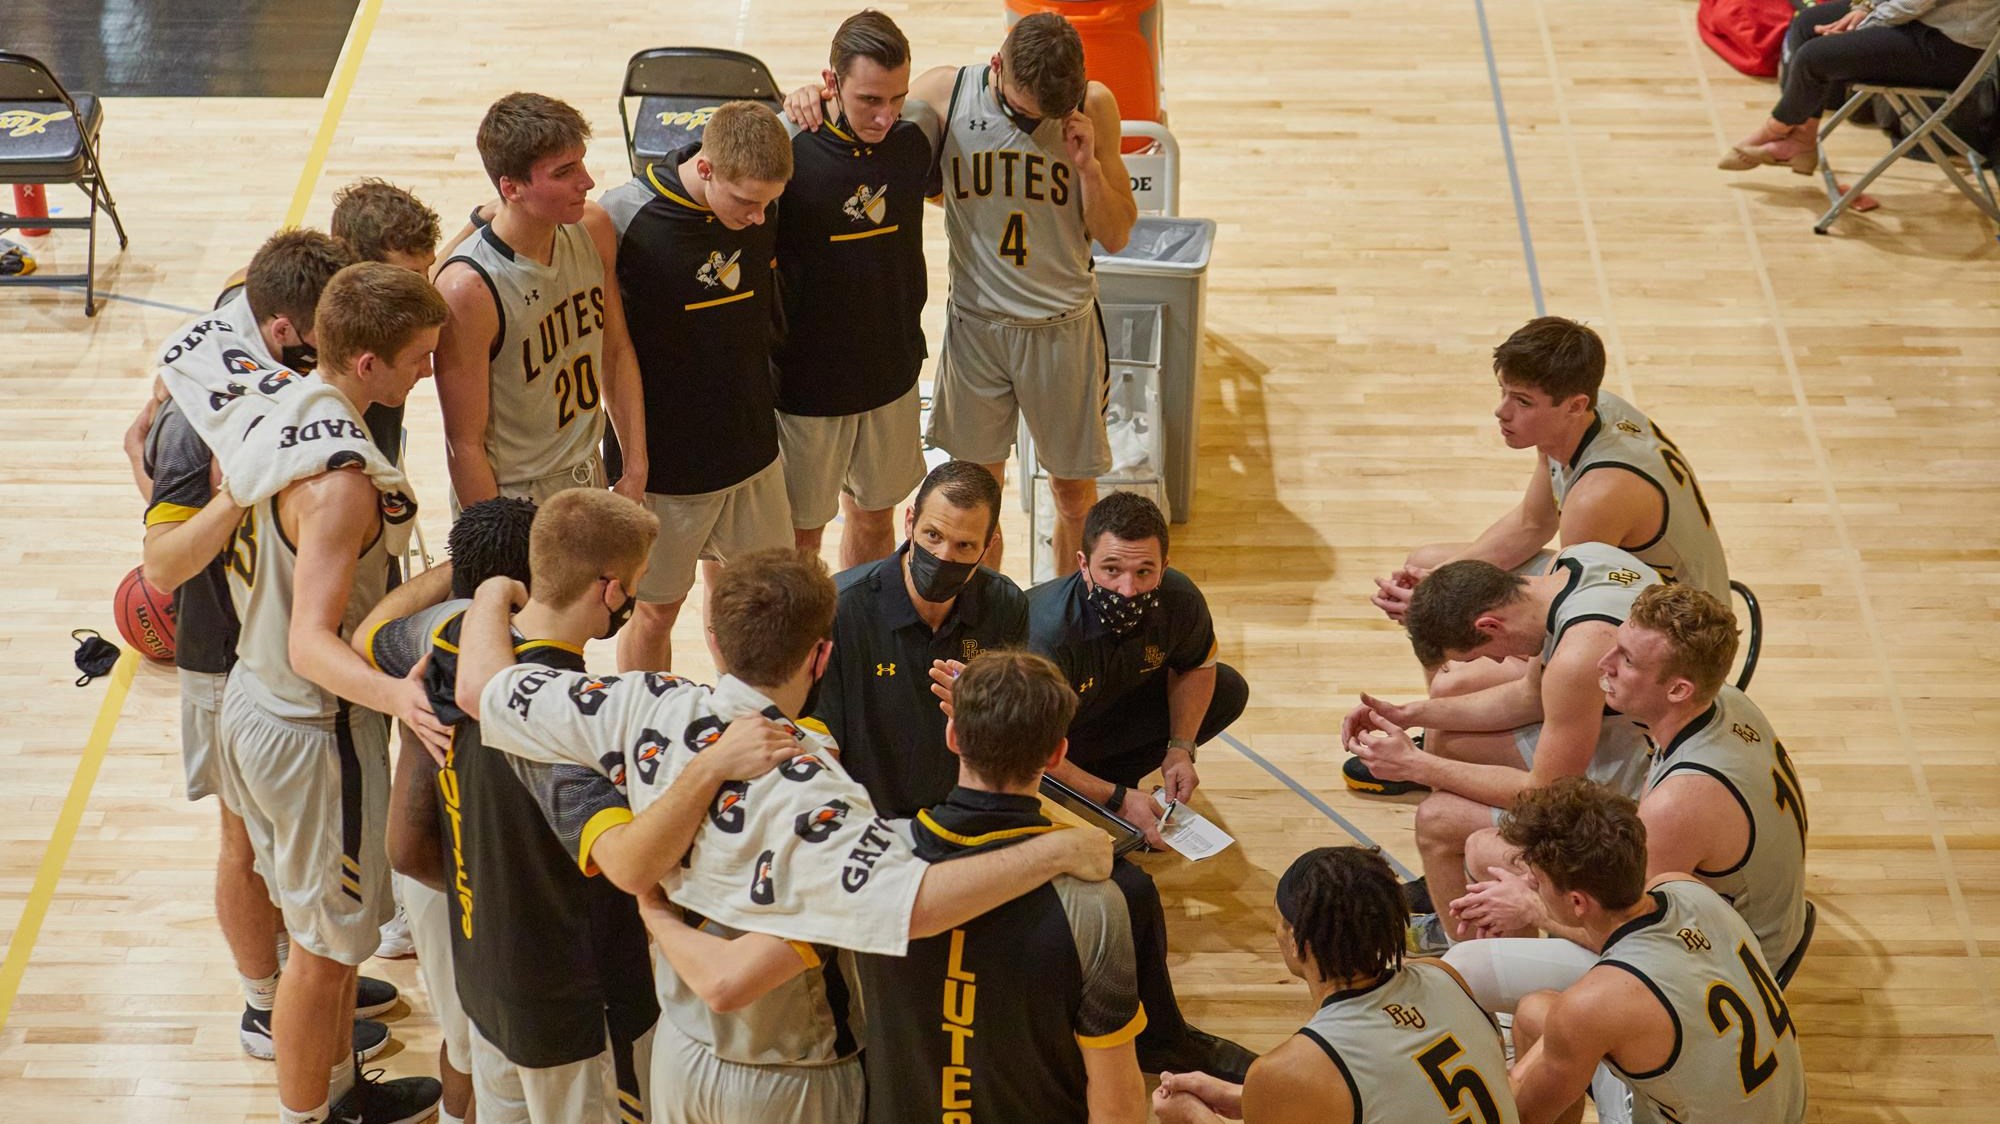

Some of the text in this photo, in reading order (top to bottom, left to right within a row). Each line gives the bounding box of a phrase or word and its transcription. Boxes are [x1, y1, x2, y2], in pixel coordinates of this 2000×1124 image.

[952, 149, 1070, 207] LUTES
[1000, 212, 1028, 267] 4
[522, 286, 604, 384] LUTES
[554, 353, 600, 431] 20
[135, 603, 175, 657] Wilson
[1382, 1003, 1426, 1030] PLU
[1706, 938, 1797, 1098] 24
[1411, 1031, 1503, 1124] 5
